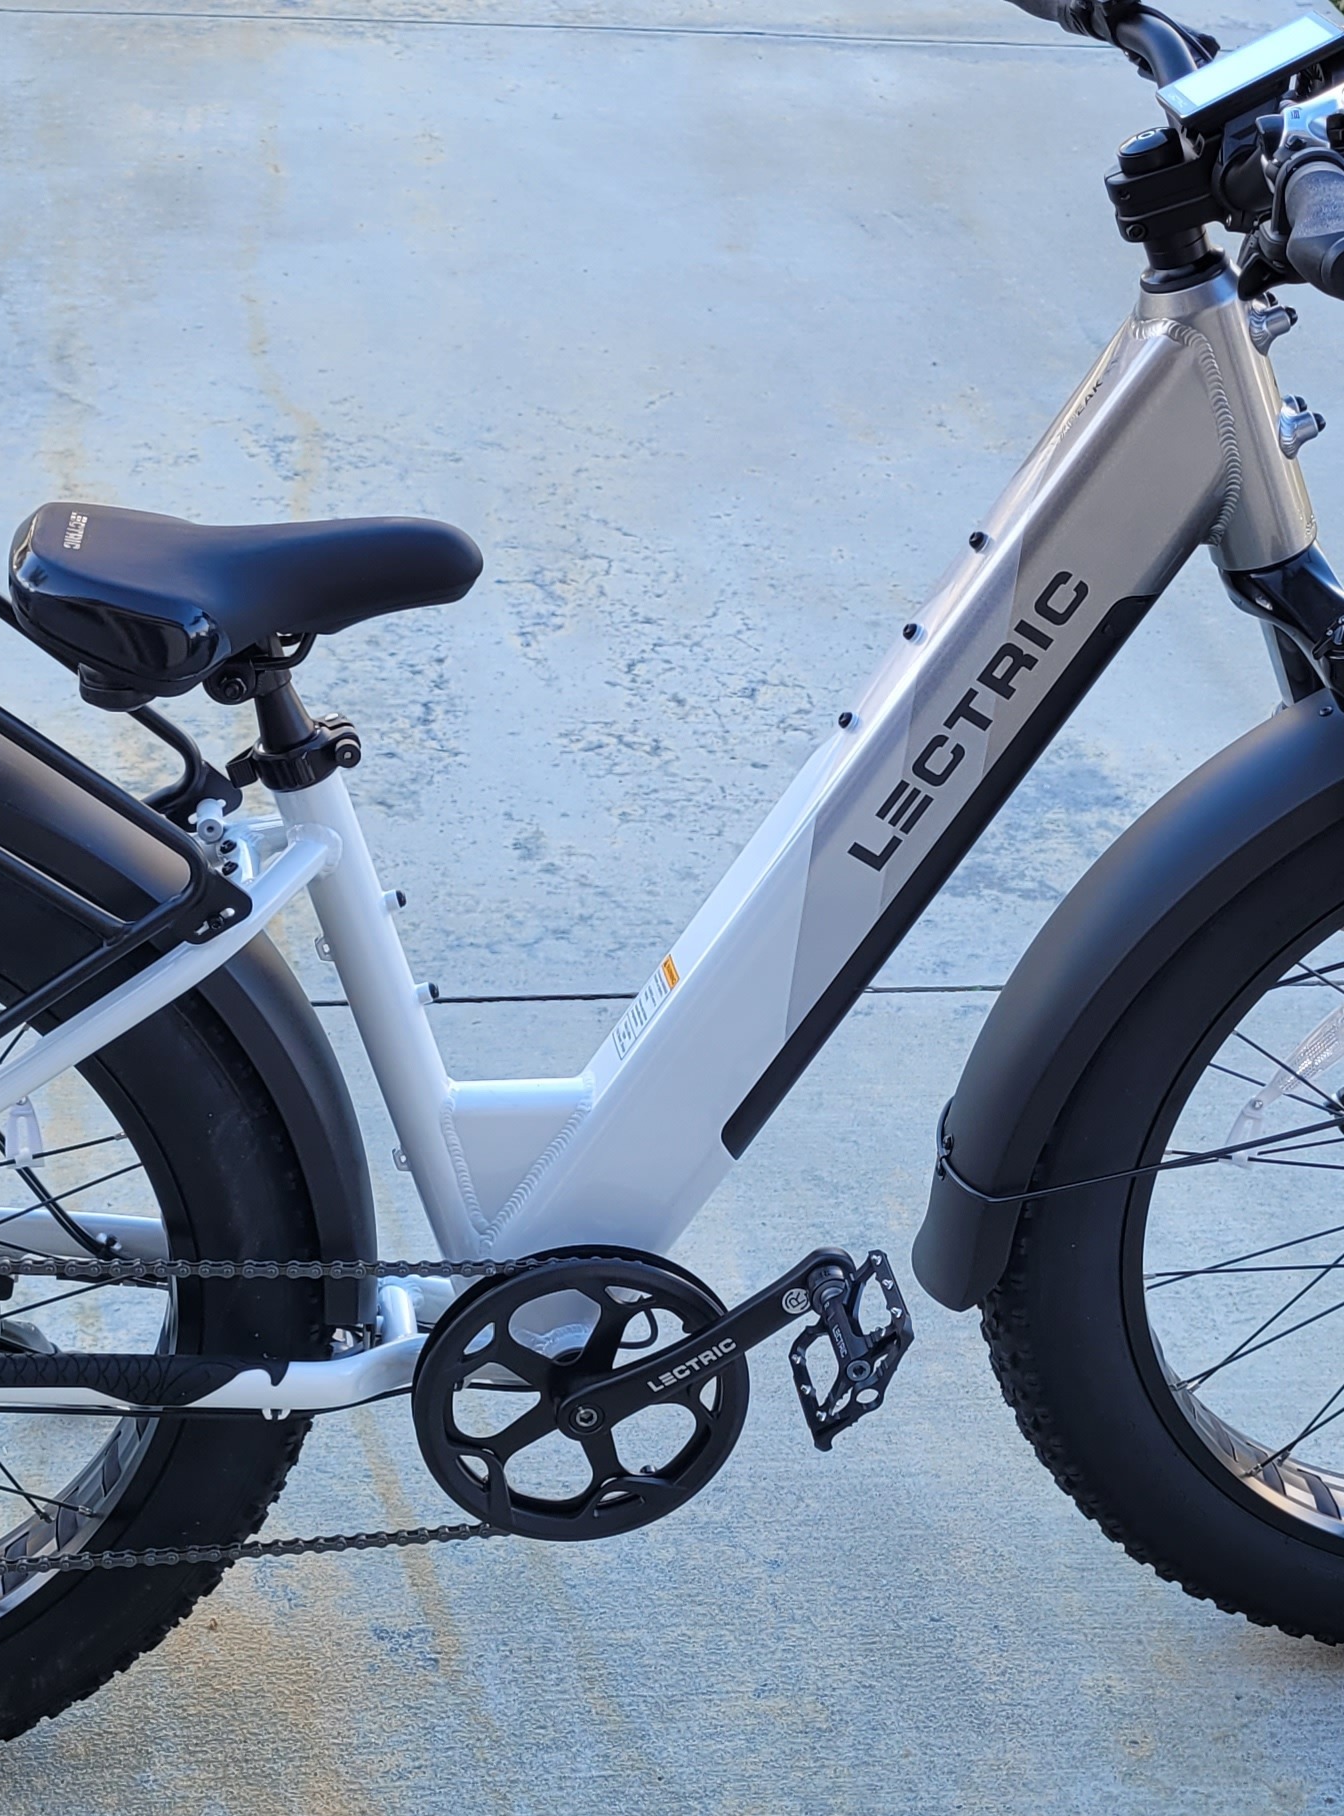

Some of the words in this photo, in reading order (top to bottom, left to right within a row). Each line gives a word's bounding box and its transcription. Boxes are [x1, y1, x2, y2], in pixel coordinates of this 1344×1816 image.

[847, 571, 1089, 872] LECTRIC
[647, 1338, 737, 1392] LECTRIC
[832, 1324, 848, 1358] LECTRIC
